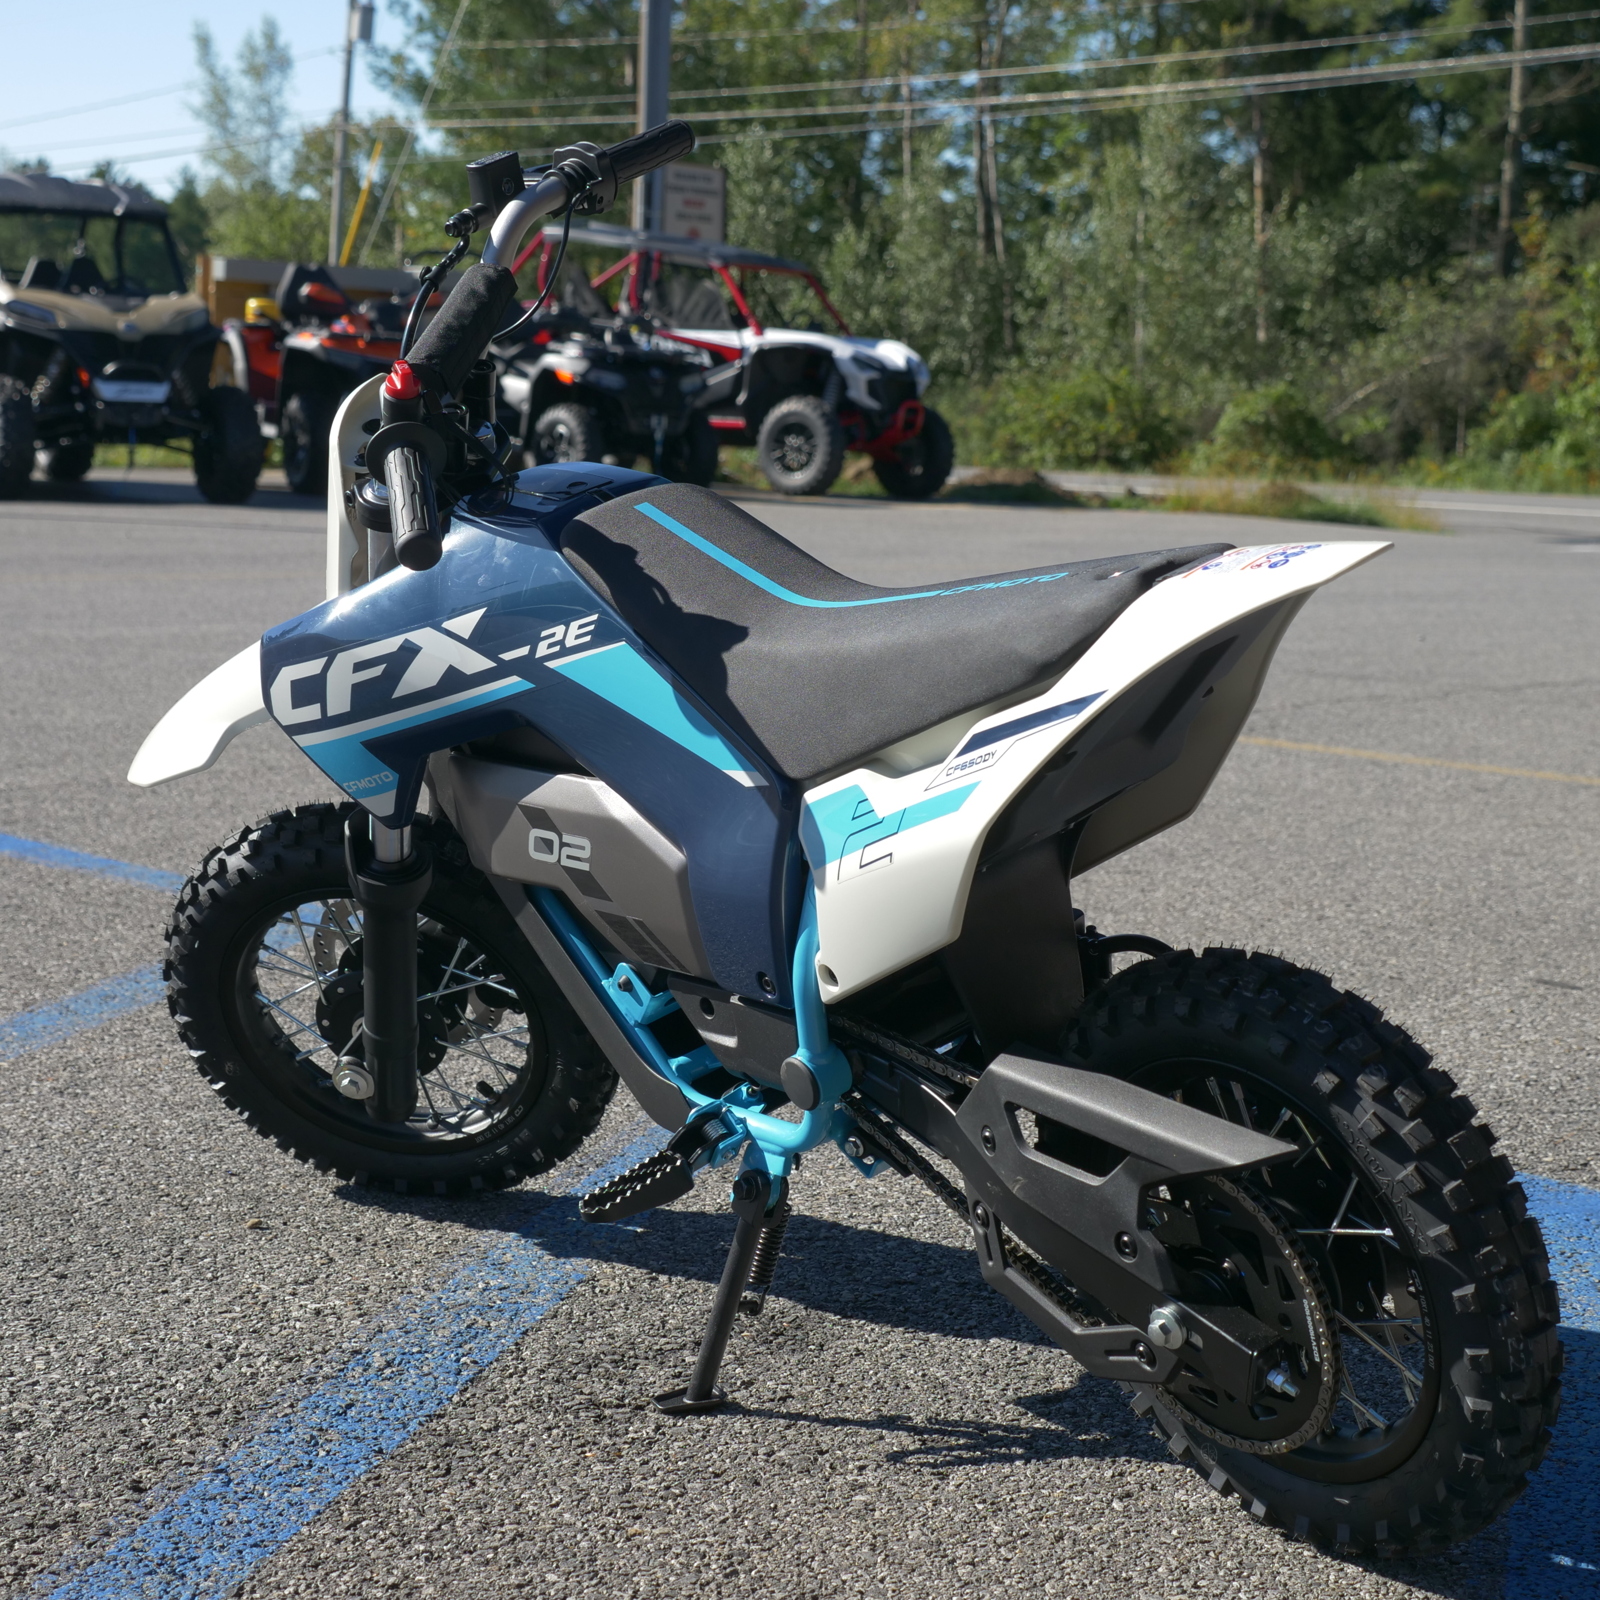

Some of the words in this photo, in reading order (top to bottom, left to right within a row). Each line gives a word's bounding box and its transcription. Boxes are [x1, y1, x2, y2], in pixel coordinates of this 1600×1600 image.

[939, 572, 1069, 596] CFMOTO
[945, 749, 998, 777] CF650DY
[342, 771, 394, 793] CFMOTO
